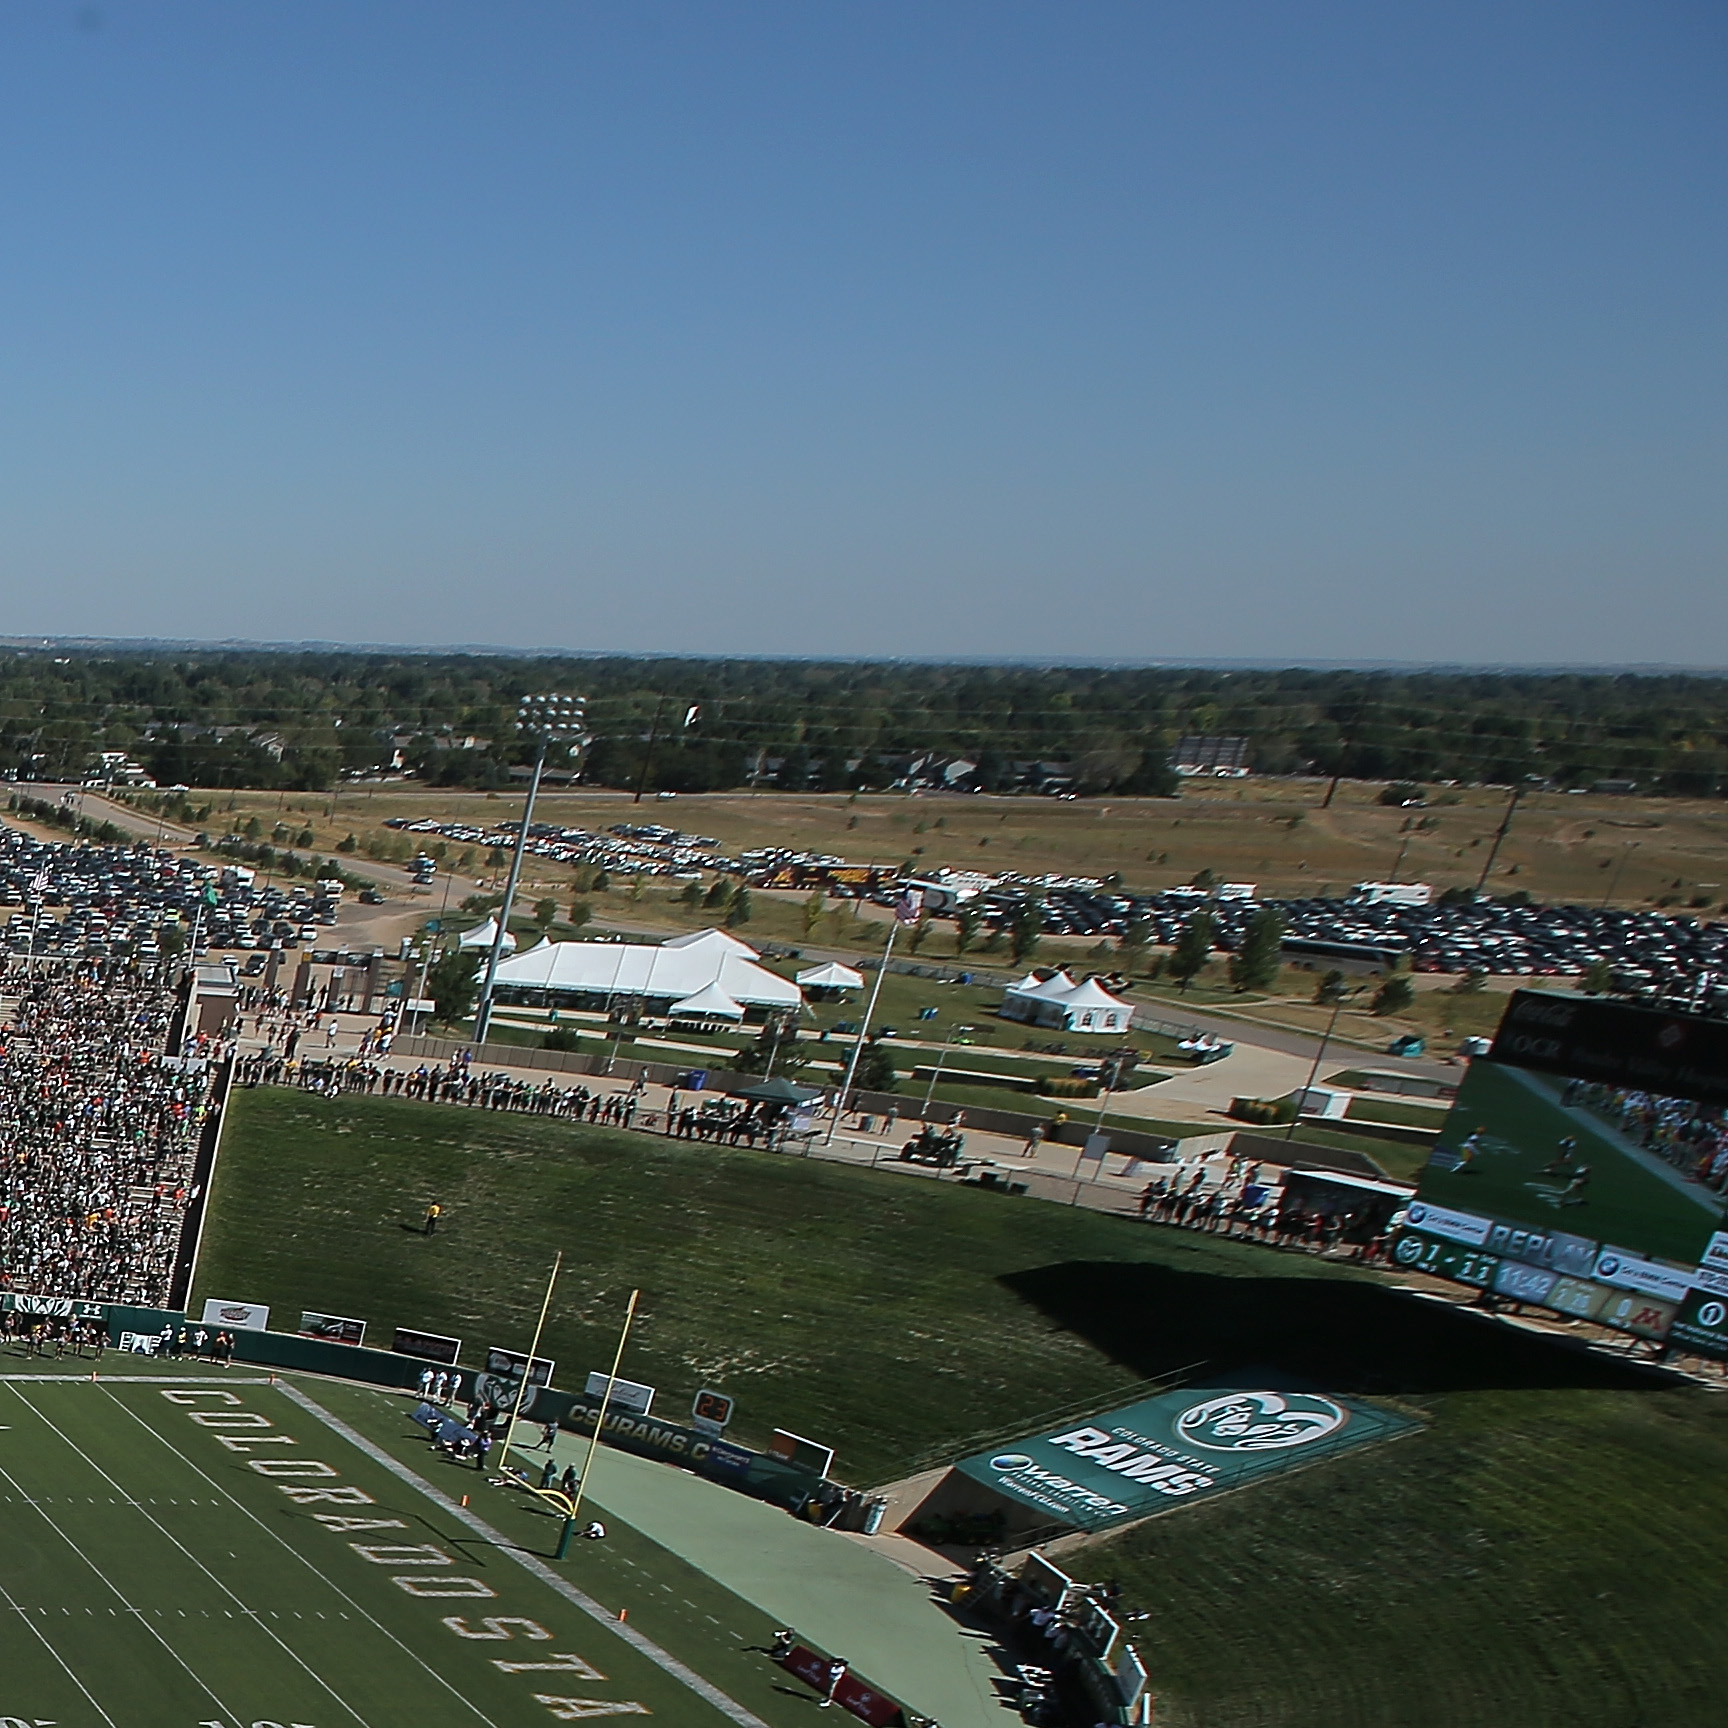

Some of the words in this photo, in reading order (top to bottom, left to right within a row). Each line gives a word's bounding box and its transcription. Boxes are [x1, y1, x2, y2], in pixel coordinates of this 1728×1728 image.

[698, 1395, 727, 1421] 23
[1047, 1426, 1215, 1496] RAMS
[1111, 1426, 1180, 1458] COLORADO
[1179, 1454, 1222, 1474] STATE
[1024, 1465, 1129, 1515] warren
